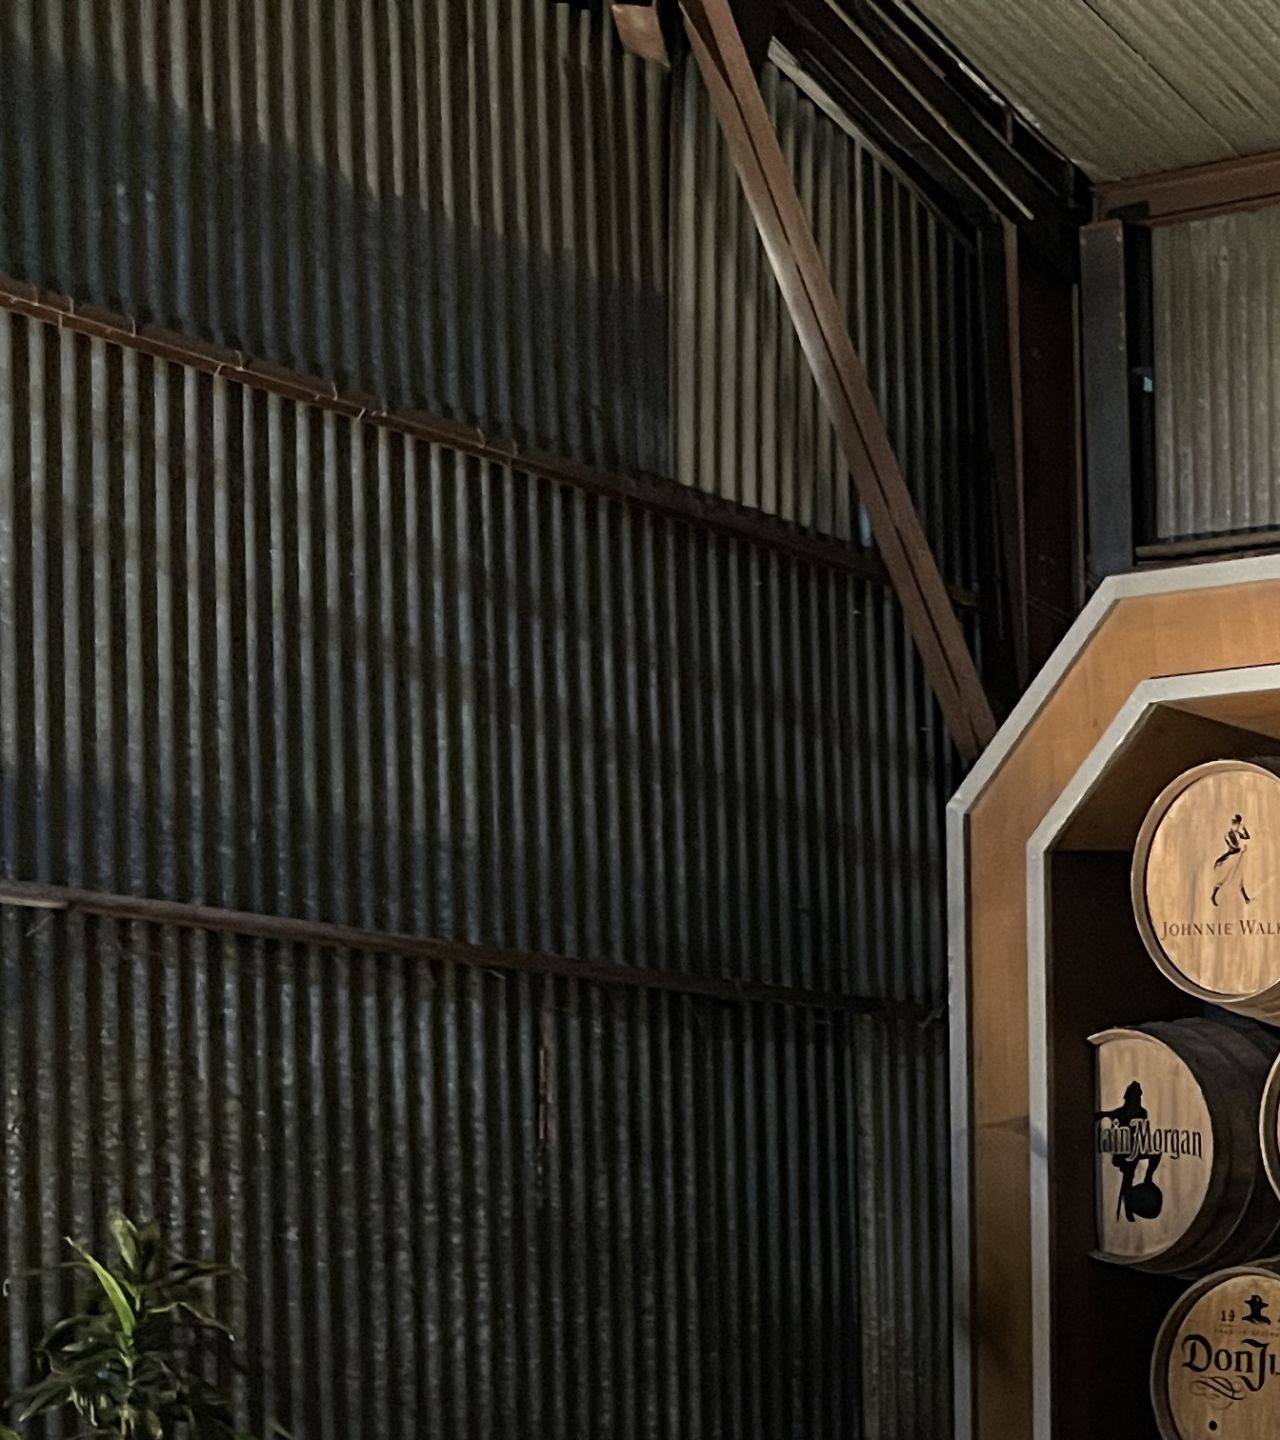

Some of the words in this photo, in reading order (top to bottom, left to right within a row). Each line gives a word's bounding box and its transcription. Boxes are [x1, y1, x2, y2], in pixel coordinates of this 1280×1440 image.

[1160, 921, 1233, 940] JOHNNIE
[1125, 1118, 1202, 1161] Morgan
[1220, 1310, 1235, 1322] 19
